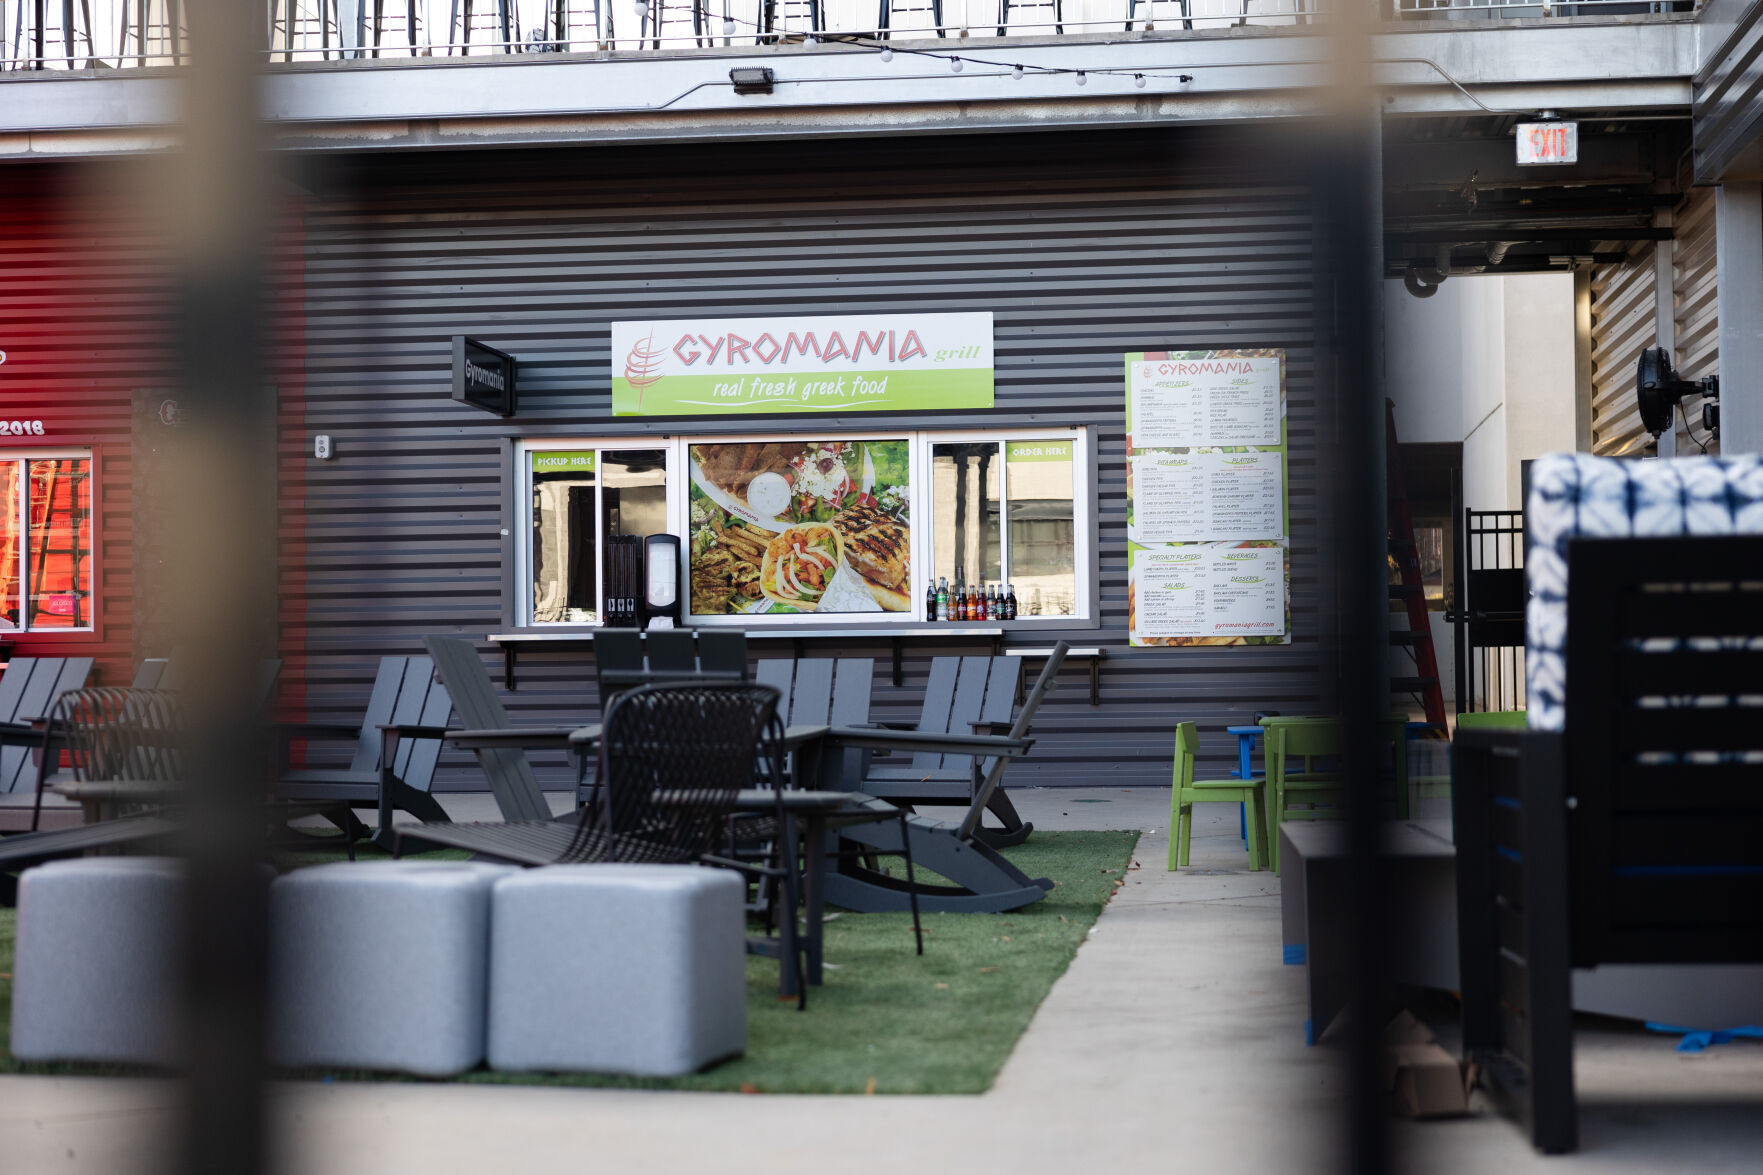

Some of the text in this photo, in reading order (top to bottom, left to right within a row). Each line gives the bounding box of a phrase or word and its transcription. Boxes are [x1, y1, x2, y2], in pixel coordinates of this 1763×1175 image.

[1529, 129, 1568, 157] EXIT
[672, 329, 981, 366] GYROMANIA grill
[465, 358, 505, 391] Gyromania
[1158, 362, 1253, 375] GYROMANIA
[713, 376, 889, 400] real fresh greek food
[0, 420, 45, 435] 2018
[537, 456, 592, 466] PICKUP HERE
[1012, 447, 1067, 456] ORDER HERE
